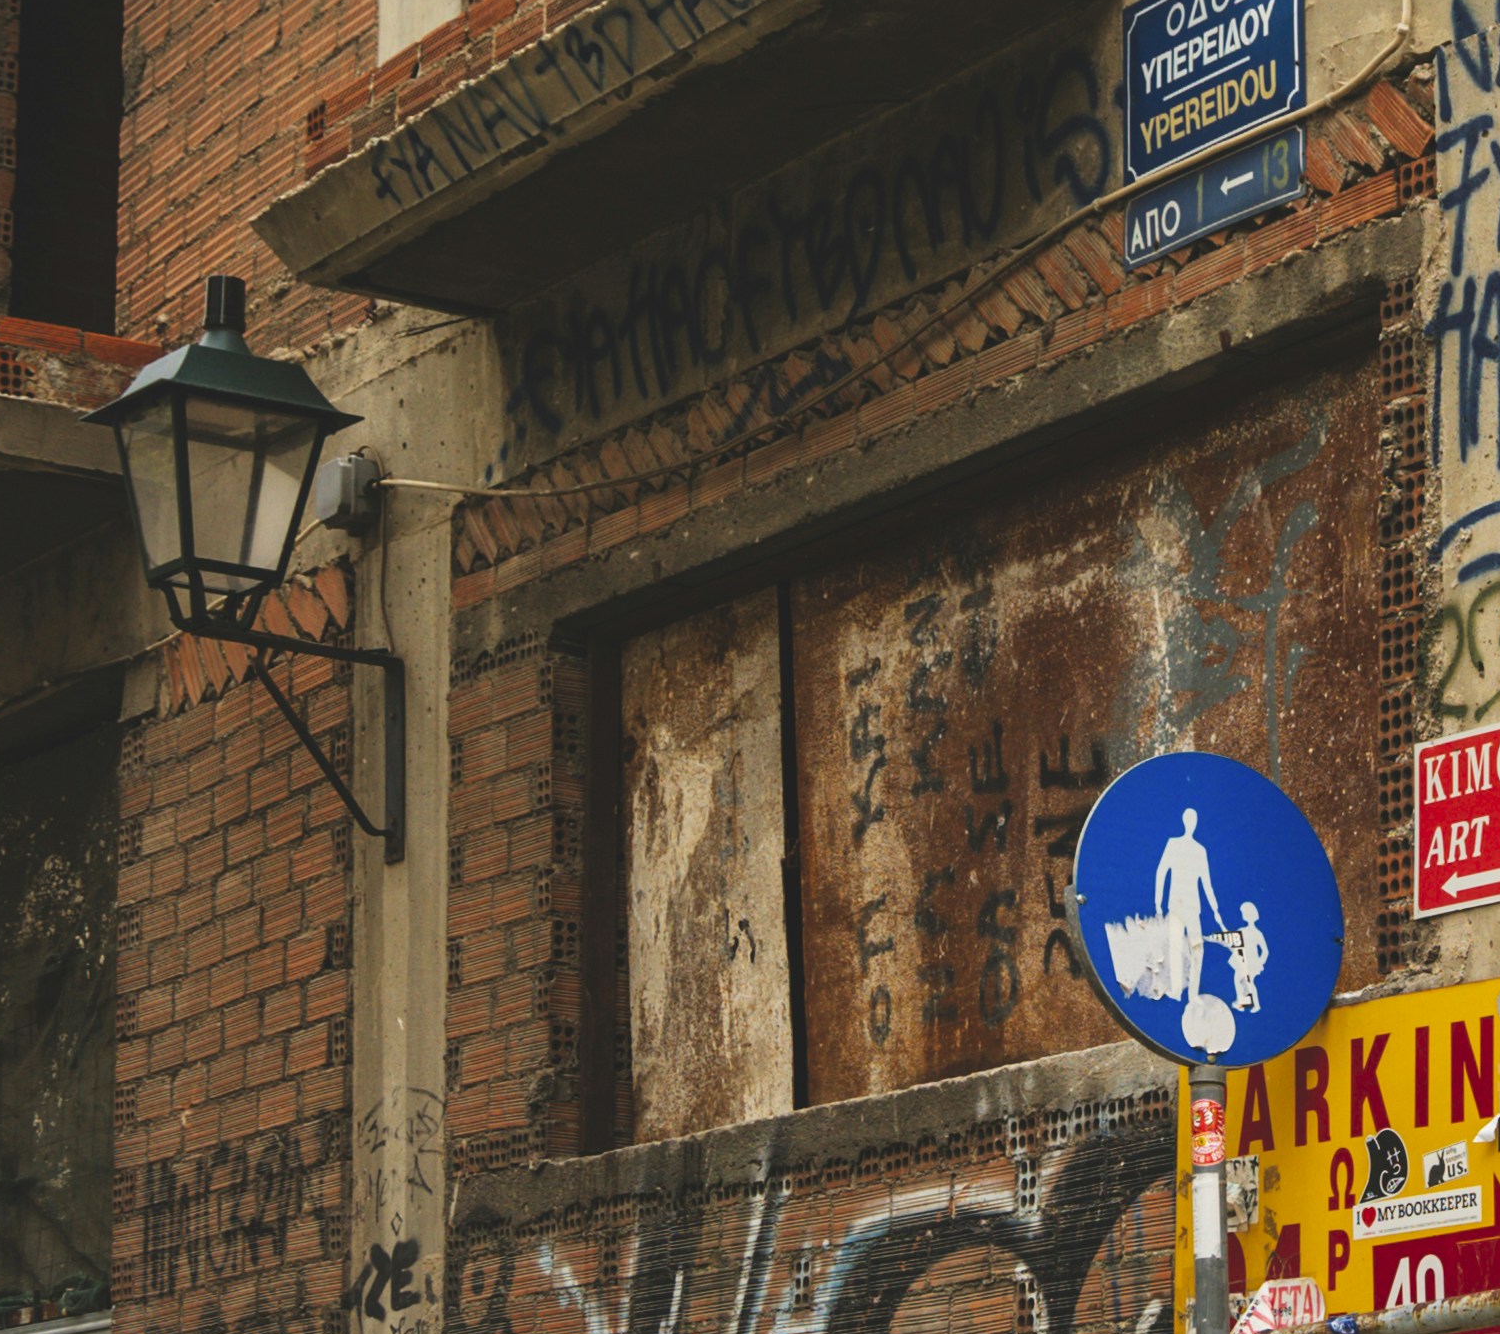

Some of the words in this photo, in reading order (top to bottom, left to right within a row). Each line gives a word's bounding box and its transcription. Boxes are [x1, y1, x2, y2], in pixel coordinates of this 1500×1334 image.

[1140, 59, 1278, 156] YPEREIDOU
[1130, 199, 1182, 255] ΑΠΟ
[1261, 137, 1290, 197] 13
[1424, 815, 1491, 870] ART
[1377, 1204, 1398, 1223] MY
[1397, 1192, 1479, 1220] BOOKKEEPER
